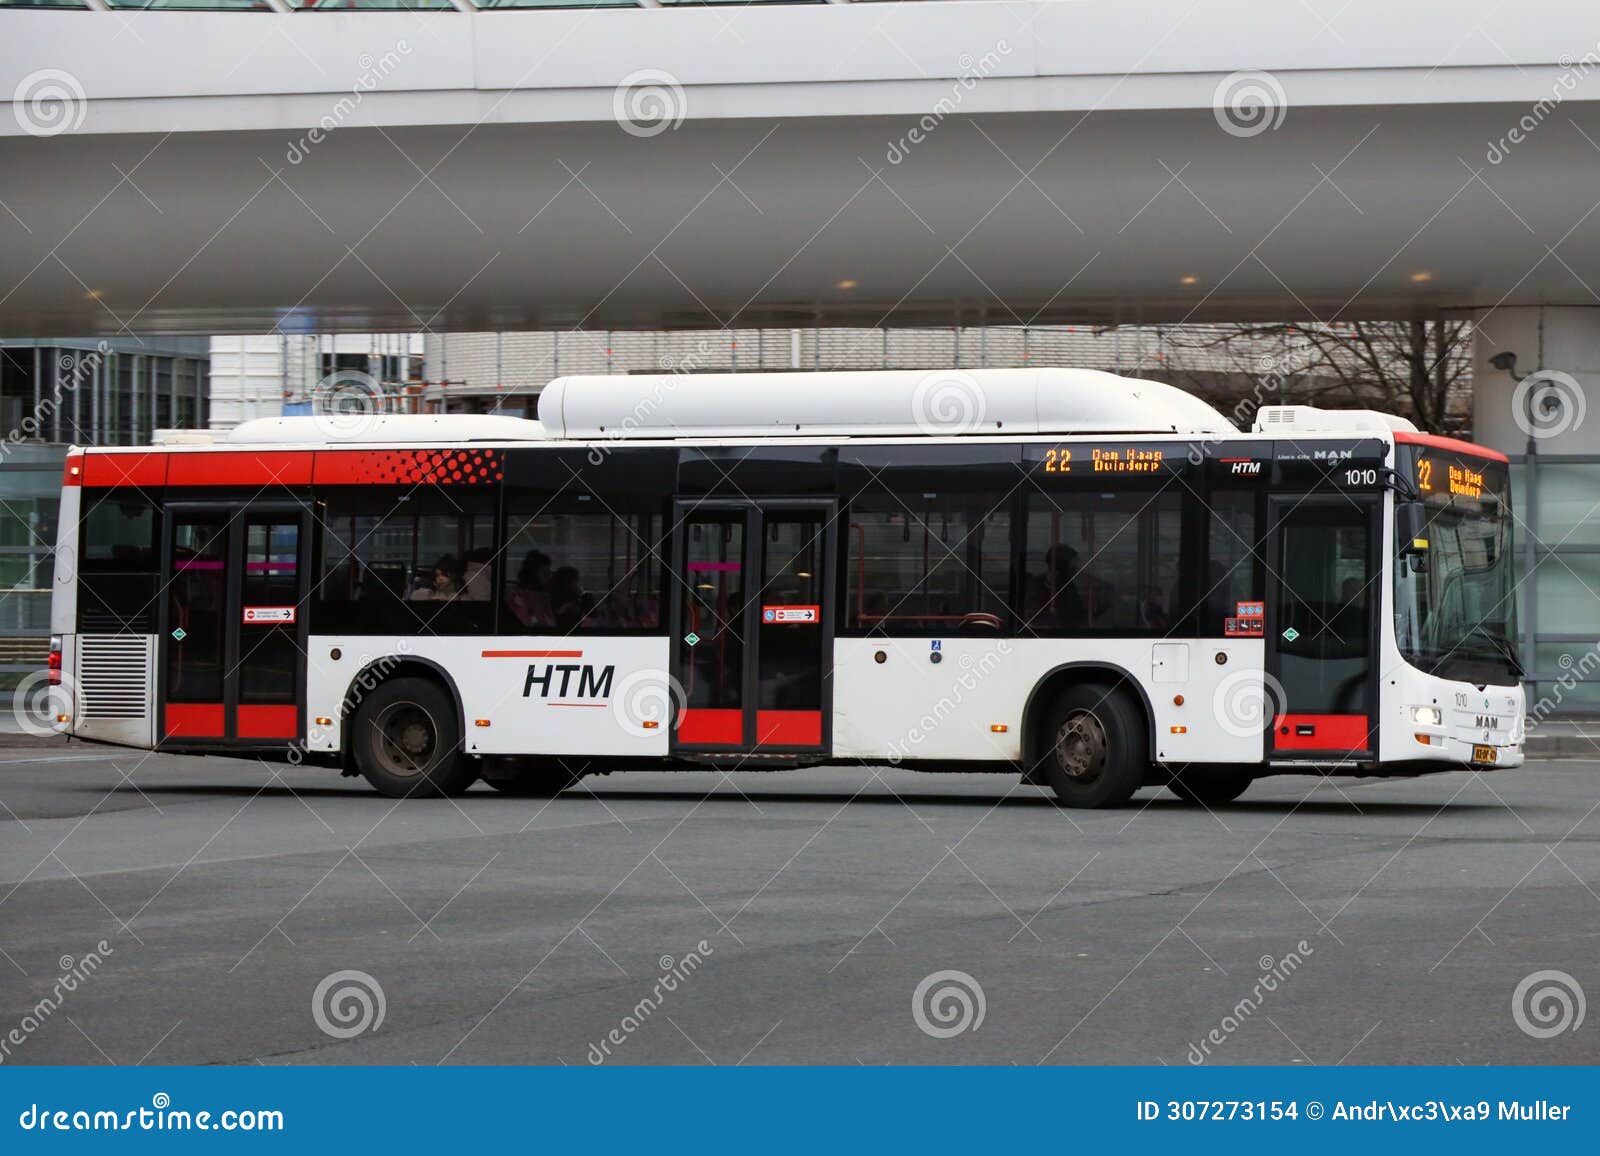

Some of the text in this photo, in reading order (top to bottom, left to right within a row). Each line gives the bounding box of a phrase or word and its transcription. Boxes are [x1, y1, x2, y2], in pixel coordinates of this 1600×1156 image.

[1046, 449, 1071, 472] 22
[1314, 450, 1352, 459] MAN
[1094, 460, 1159, 472] Duindorp
[1232, 462, 1260, 473] HTM
[1345, 469, 1376, 485] 1010
[1418, 459, 1431, 490] 22
[523, 664, 615, 698] HTM
[1476, 715, 1498, 729] MAN
